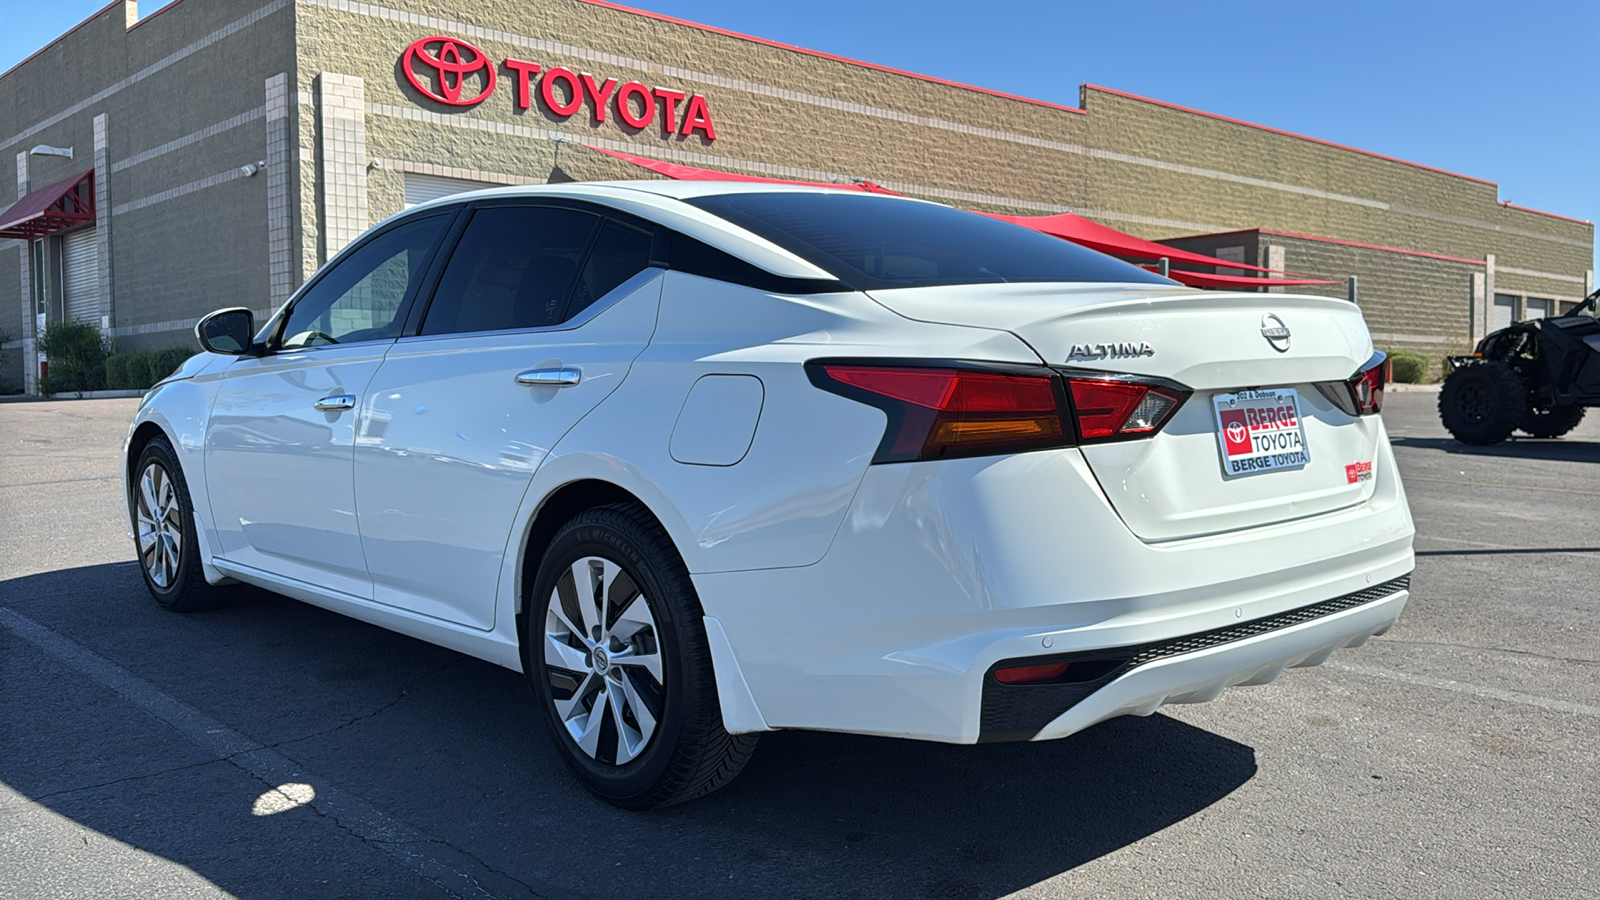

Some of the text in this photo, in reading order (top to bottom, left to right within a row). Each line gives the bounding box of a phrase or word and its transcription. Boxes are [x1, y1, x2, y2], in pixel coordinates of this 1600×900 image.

[504, 58, 717, 140] TOYOTA
[1068, 341, 1154, 360] ALTIMA
[1237, 392, 1247, 400] 202
[1246, 405, 1297, 431] BERGE
[1253, 431, 1301, 452] TOYOTA
[1231, 451, 1307, 472] BERGE TOYOTA
[592, 530, 639, 562] MICHELIN
